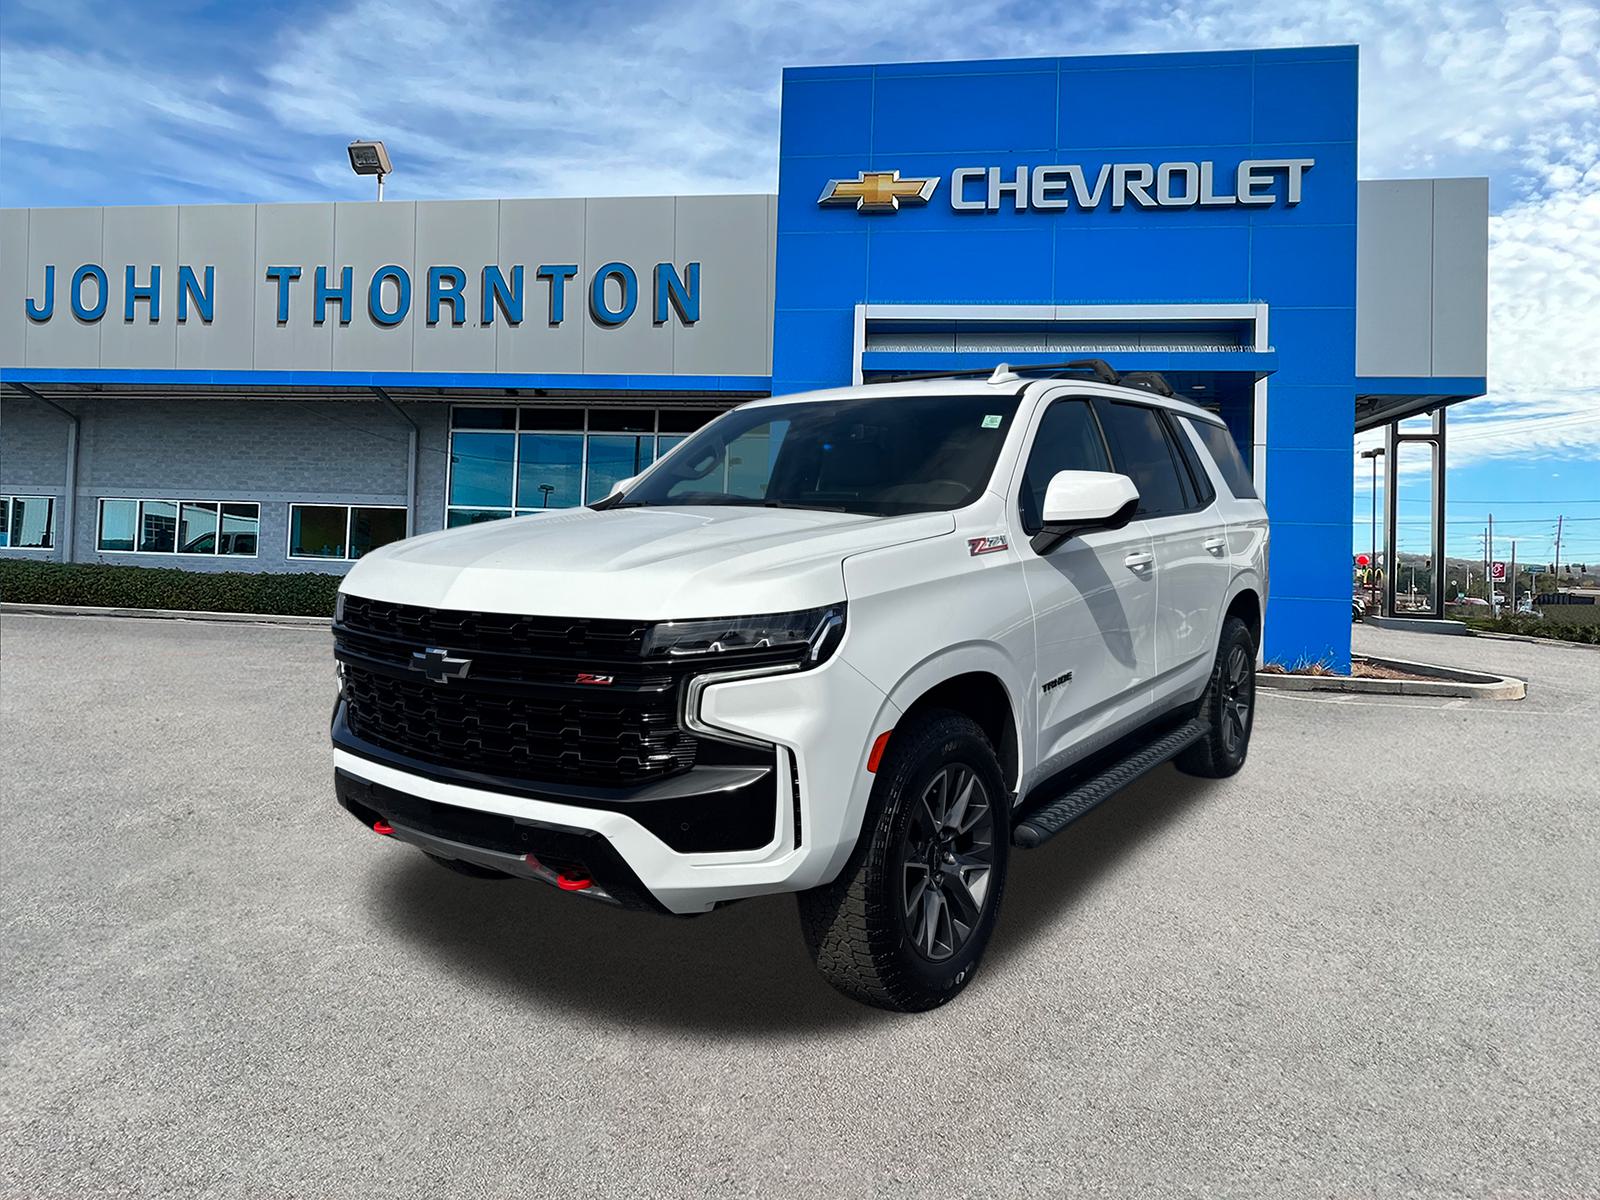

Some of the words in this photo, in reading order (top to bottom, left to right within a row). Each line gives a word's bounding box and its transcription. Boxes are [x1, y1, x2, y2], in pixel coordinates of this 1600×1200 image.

[951, 158, 1315, 210] CHEVROLET
[25, 264, 214, 323] JOHN
[266, 261, 701, 327] THORNTON
[968, 535, 1008, 557] Z71
[575, 673, 615, 684] Z71
[1042, 671, 1072, 693] TAHOE
